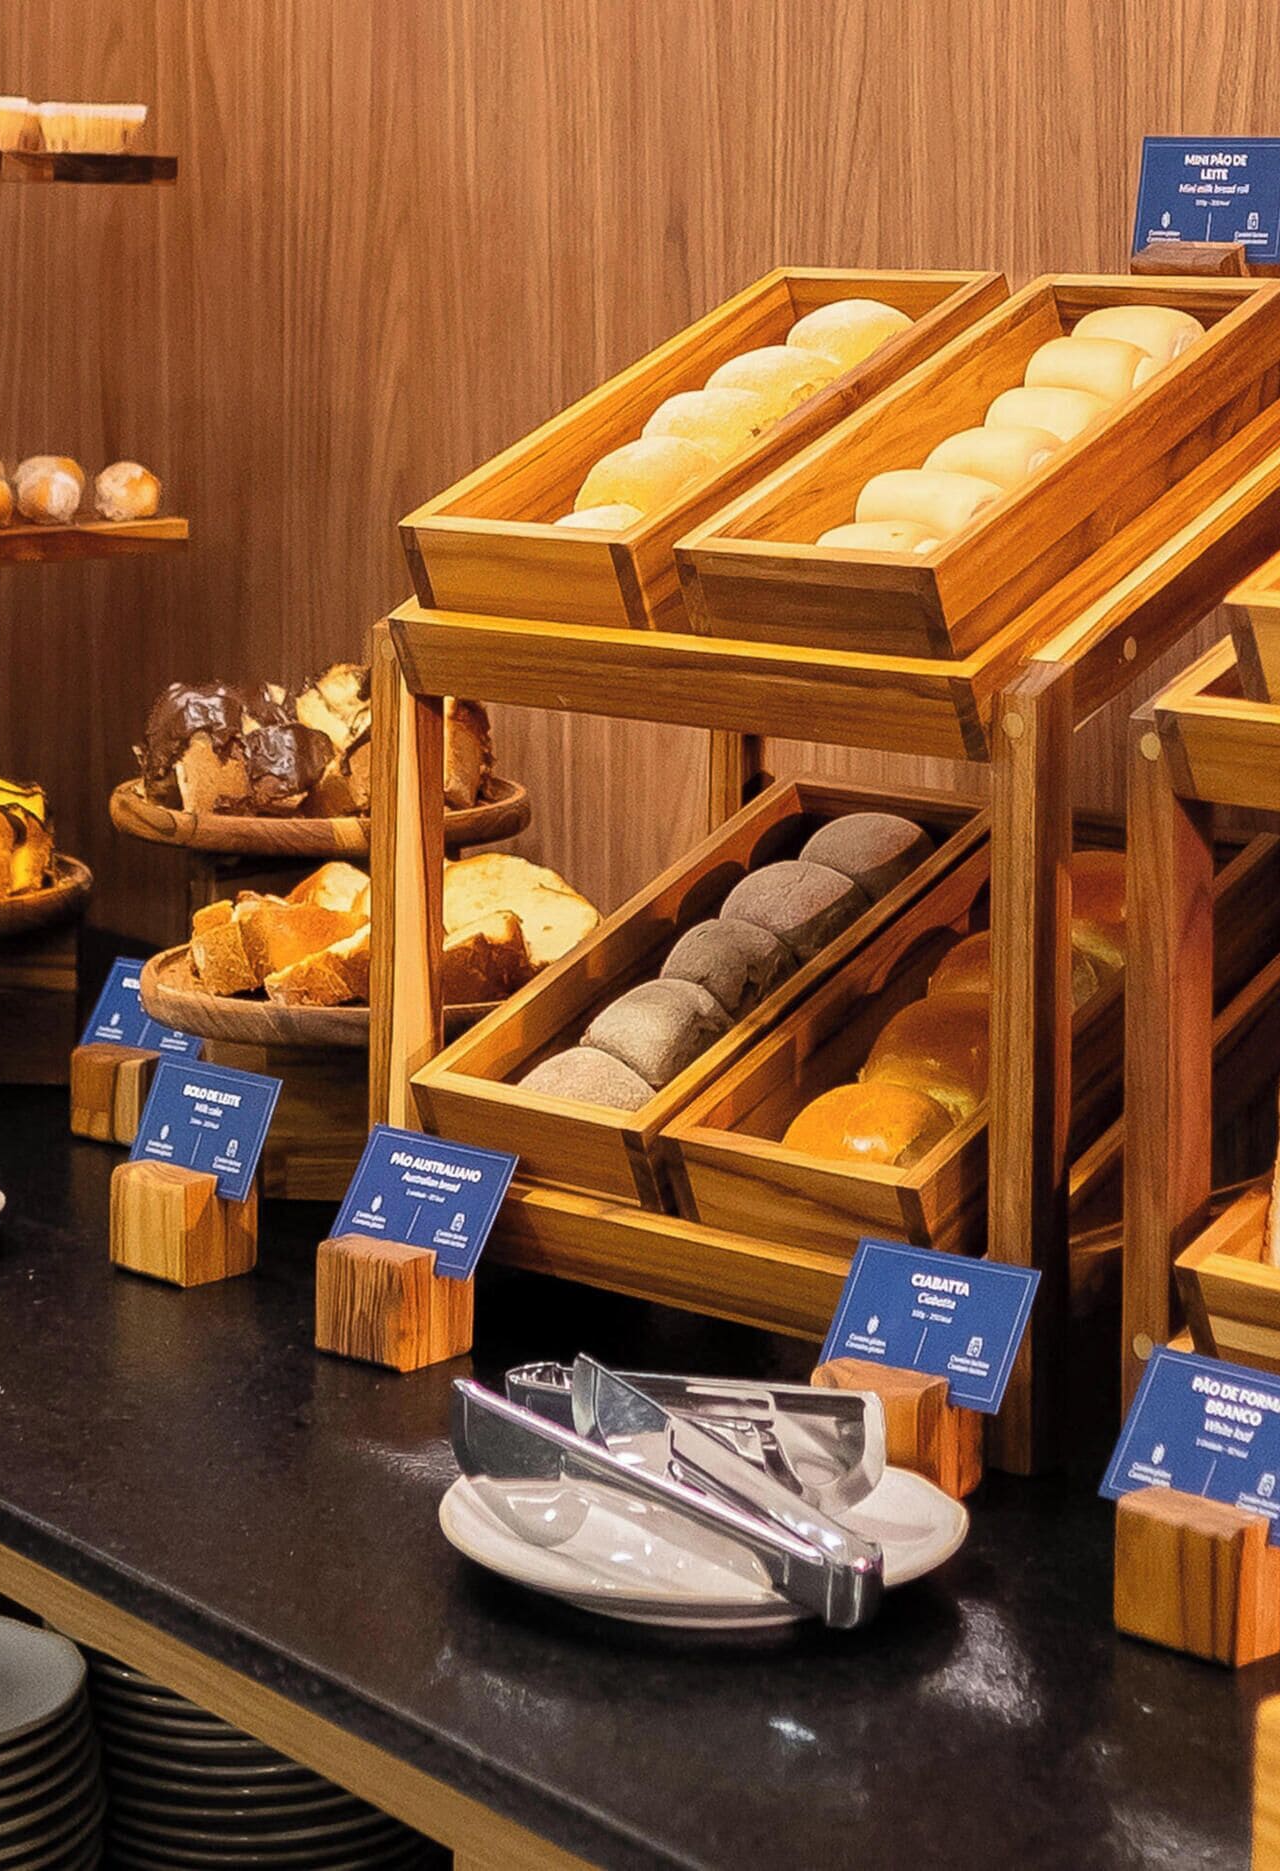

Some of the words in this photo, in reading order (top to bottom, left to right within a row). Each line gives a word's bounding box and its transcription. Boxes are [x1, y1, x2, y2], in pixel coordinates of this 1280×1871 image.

[1184, 154, 1209, 167] MINI
[1210, 152, 1232, 167] PÃO
[1233, 154, 1248, 167] DE
[1200, 168, 1229, 181] LEITE
[183, 1084, 207, 1100] BOLO
[207, 1090, 221, 1103] DE
[221, 1092, 242, 1107] LEITE
[390, 1151, 413, 1167] PÃO
[412, 1158, 482, 1183] AUSTRALIANO
[911, 1273, 970, 1297] CIABATTA
[918, 1292, 956, 1310] Ciabatta
[1192, 1375, 1220, 1397] PÃO
[1221, 1384, 1239, 1402] DE
[1204, 1400, 1262, 1426] BRANCO
[1204, 1418, 1233, 1437] White
